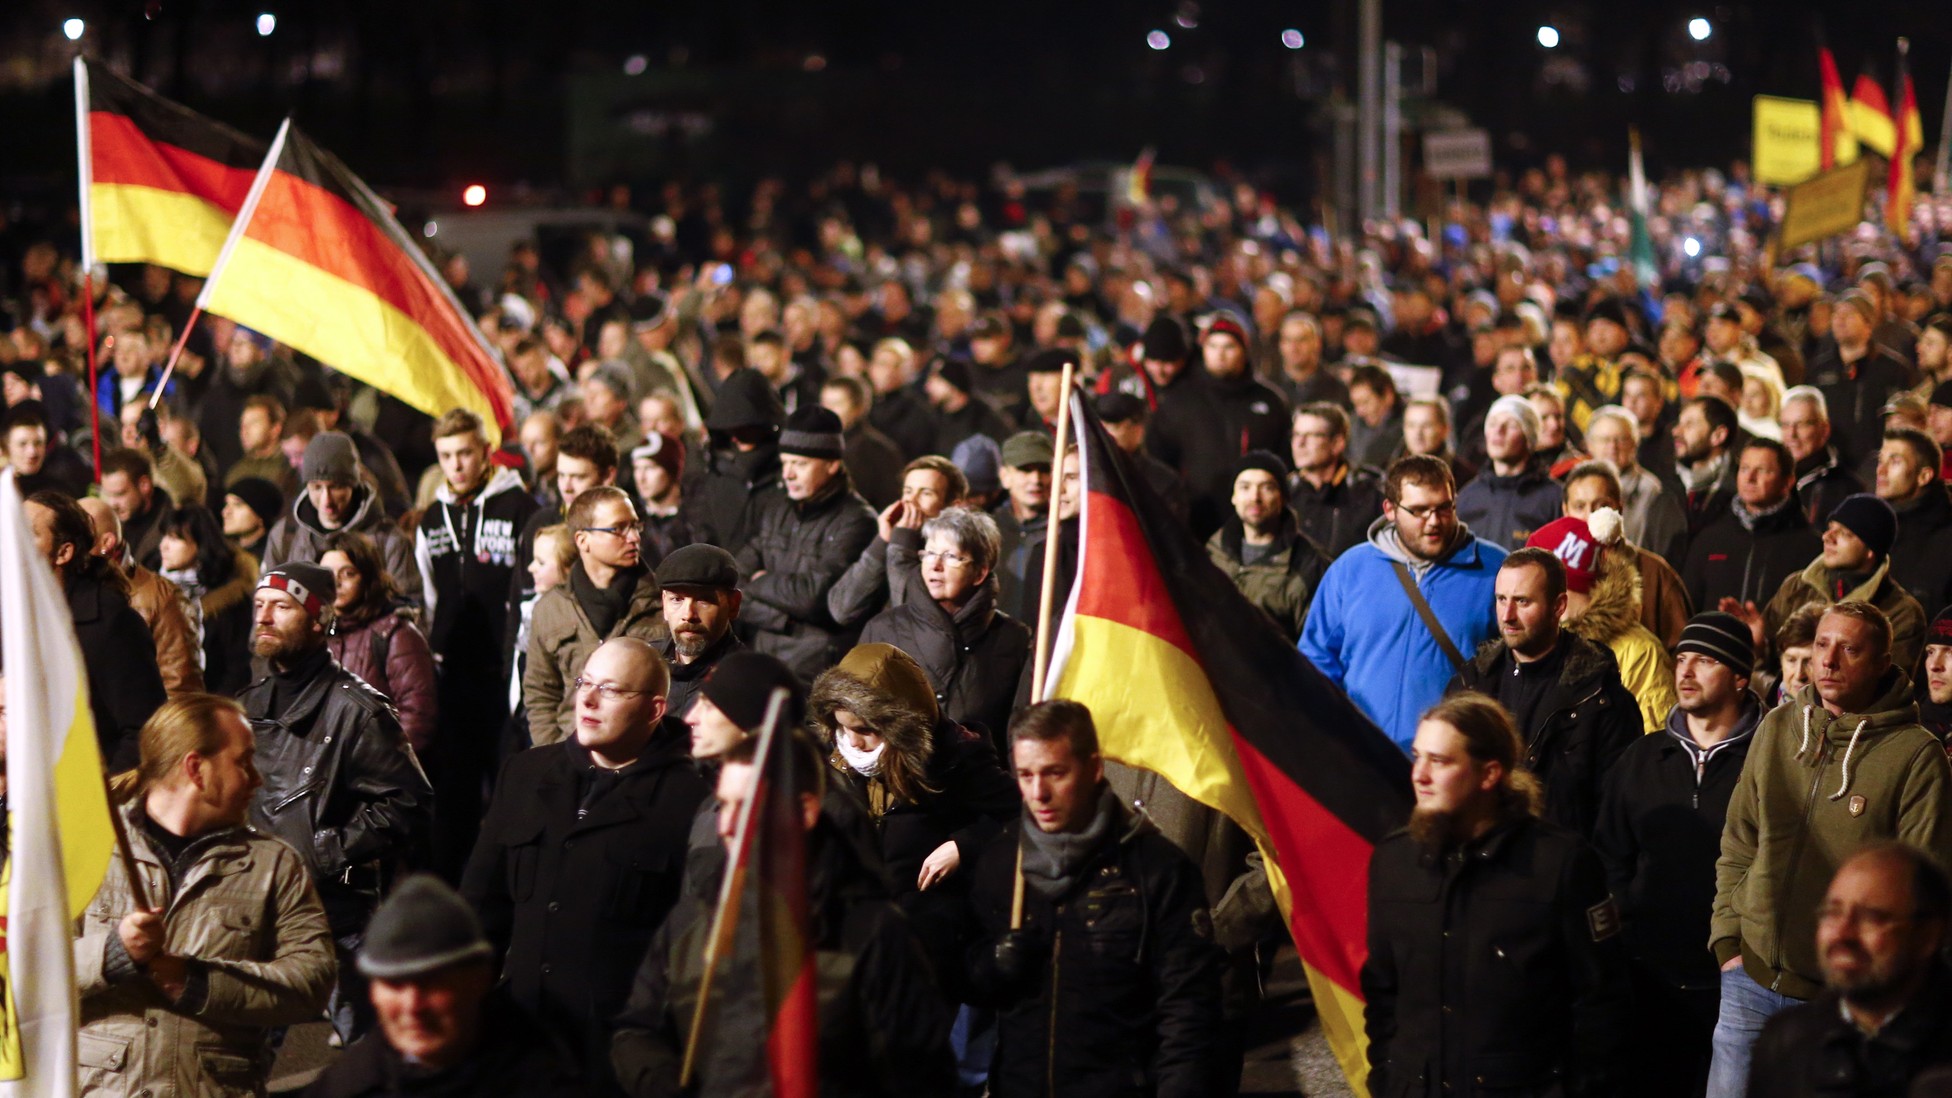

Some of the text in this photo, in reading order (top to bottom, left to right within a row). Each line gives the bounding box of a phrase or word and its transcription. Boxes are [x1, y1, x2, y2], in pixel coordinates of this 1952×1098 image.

[483, 519, 513, 537] NEW
[480, 536, 516, 554] YORK
[1553, 531, 1601, 572] M
